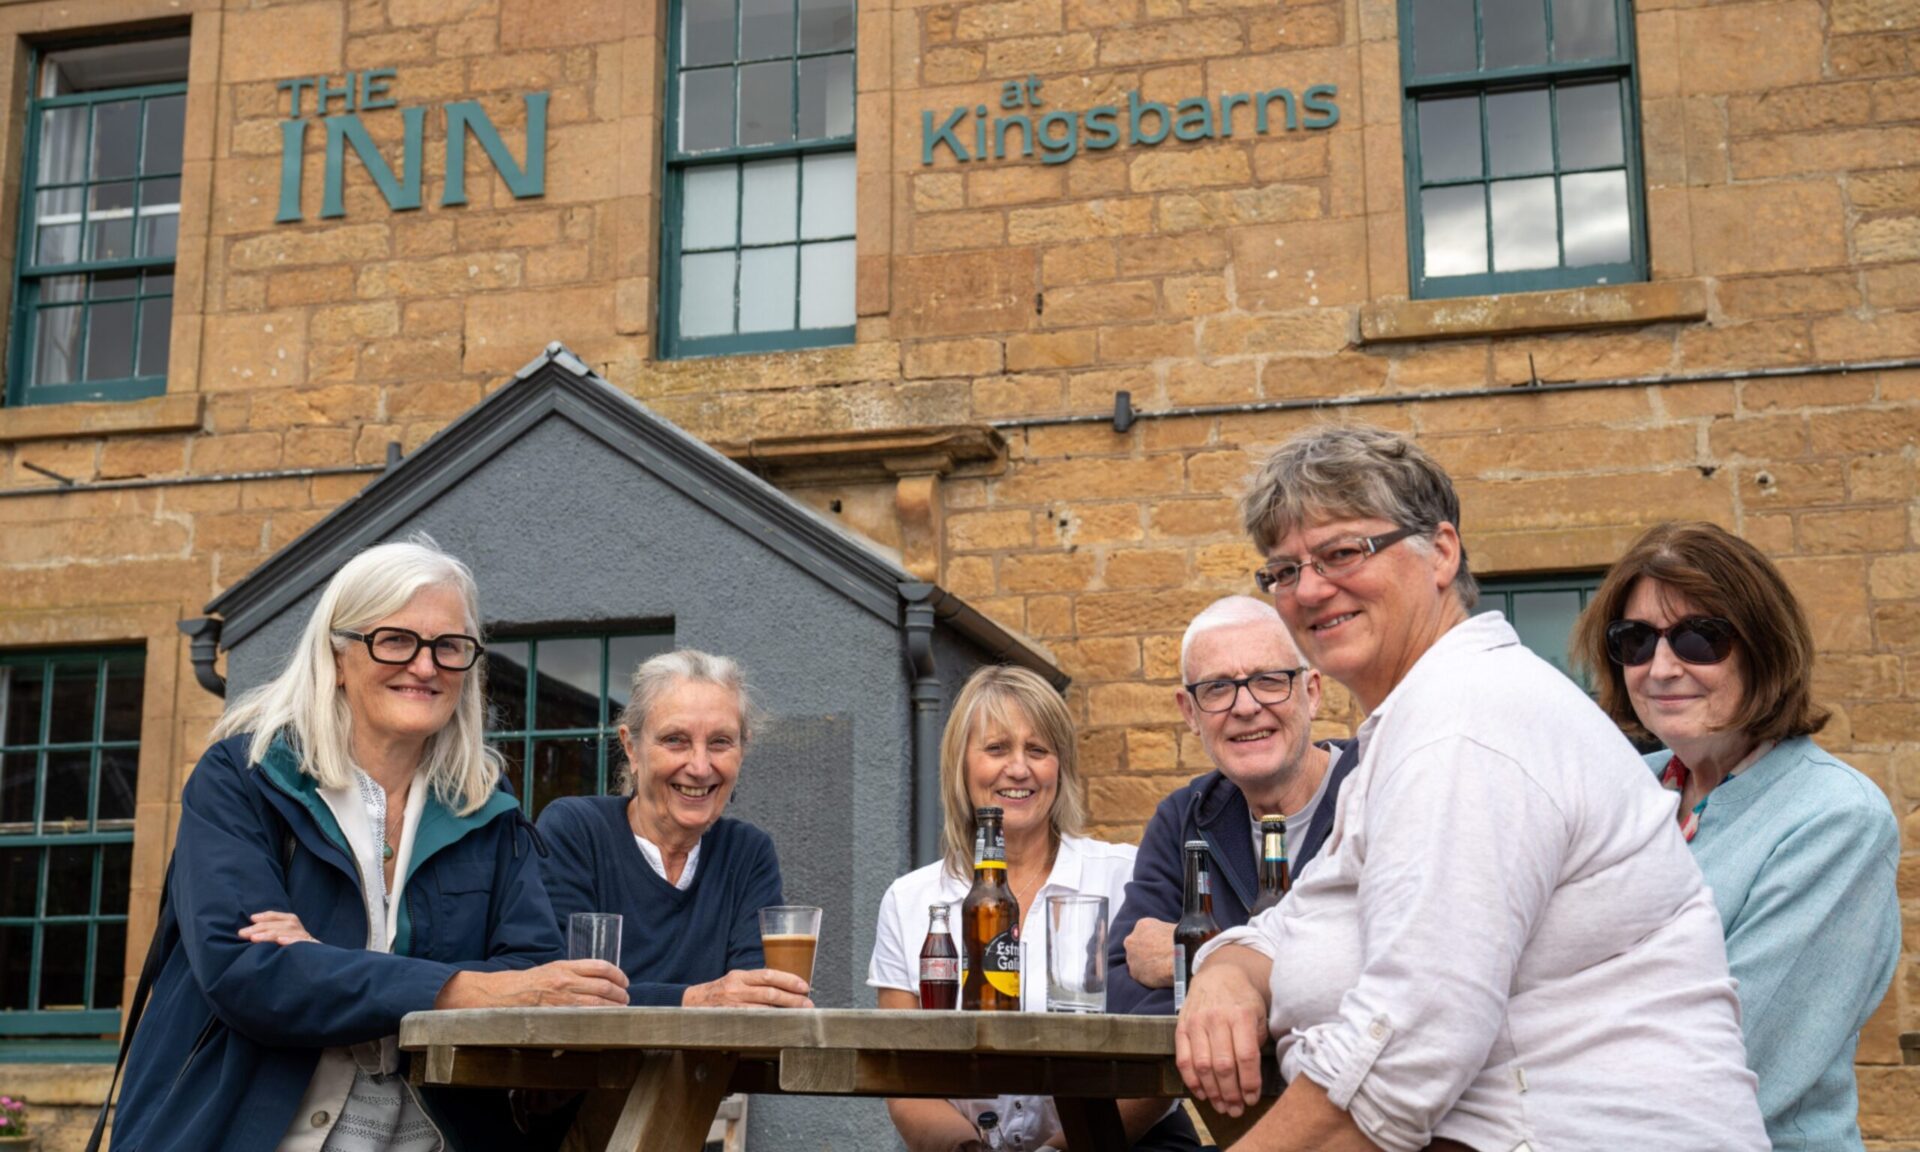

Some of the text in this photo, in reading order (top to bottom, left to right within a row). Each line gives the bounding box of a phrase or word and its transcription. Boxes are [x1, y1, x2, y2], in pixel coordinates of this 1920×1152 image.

[277, 67, 398, 118] THE
[921, 83, 1341, 165] Kingsbarns
[1000, 74, 1043, 109] at
[274, 91, 550, 223] INN
